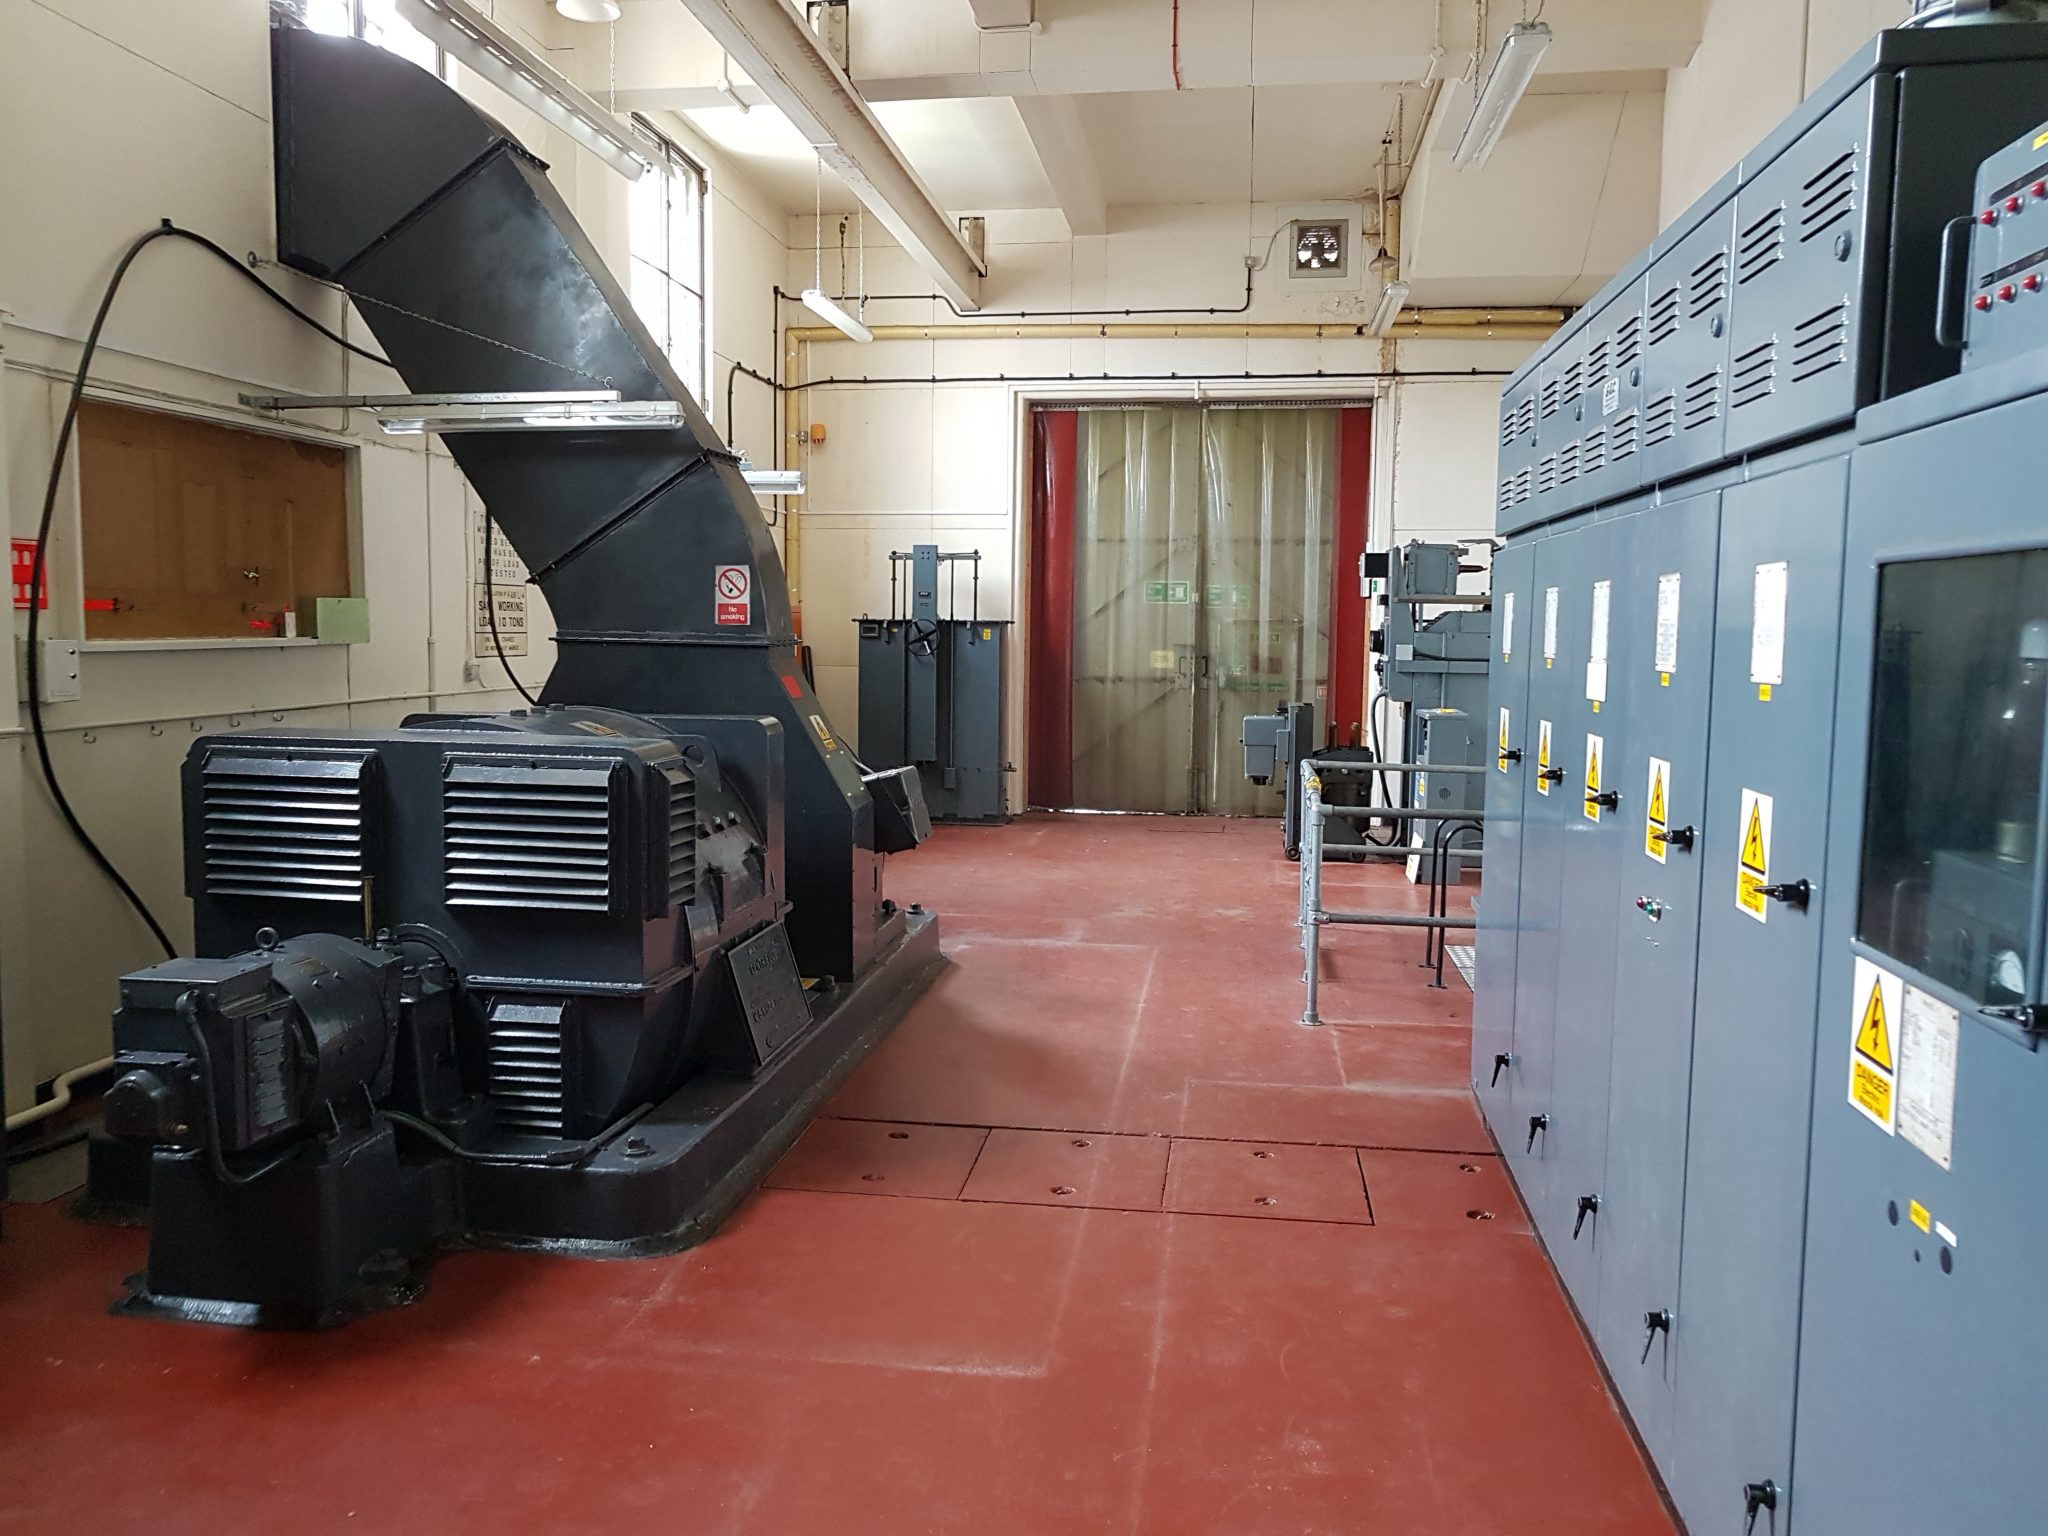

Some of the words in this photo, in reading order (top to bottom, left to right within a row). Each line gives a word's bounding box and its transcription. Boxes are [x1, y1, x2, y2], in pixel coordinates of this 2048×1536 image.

[497, 601, 524, 612] WORKING
[509, 616, 524, 627] TONS
[720, 613, 745, 622] smoking
